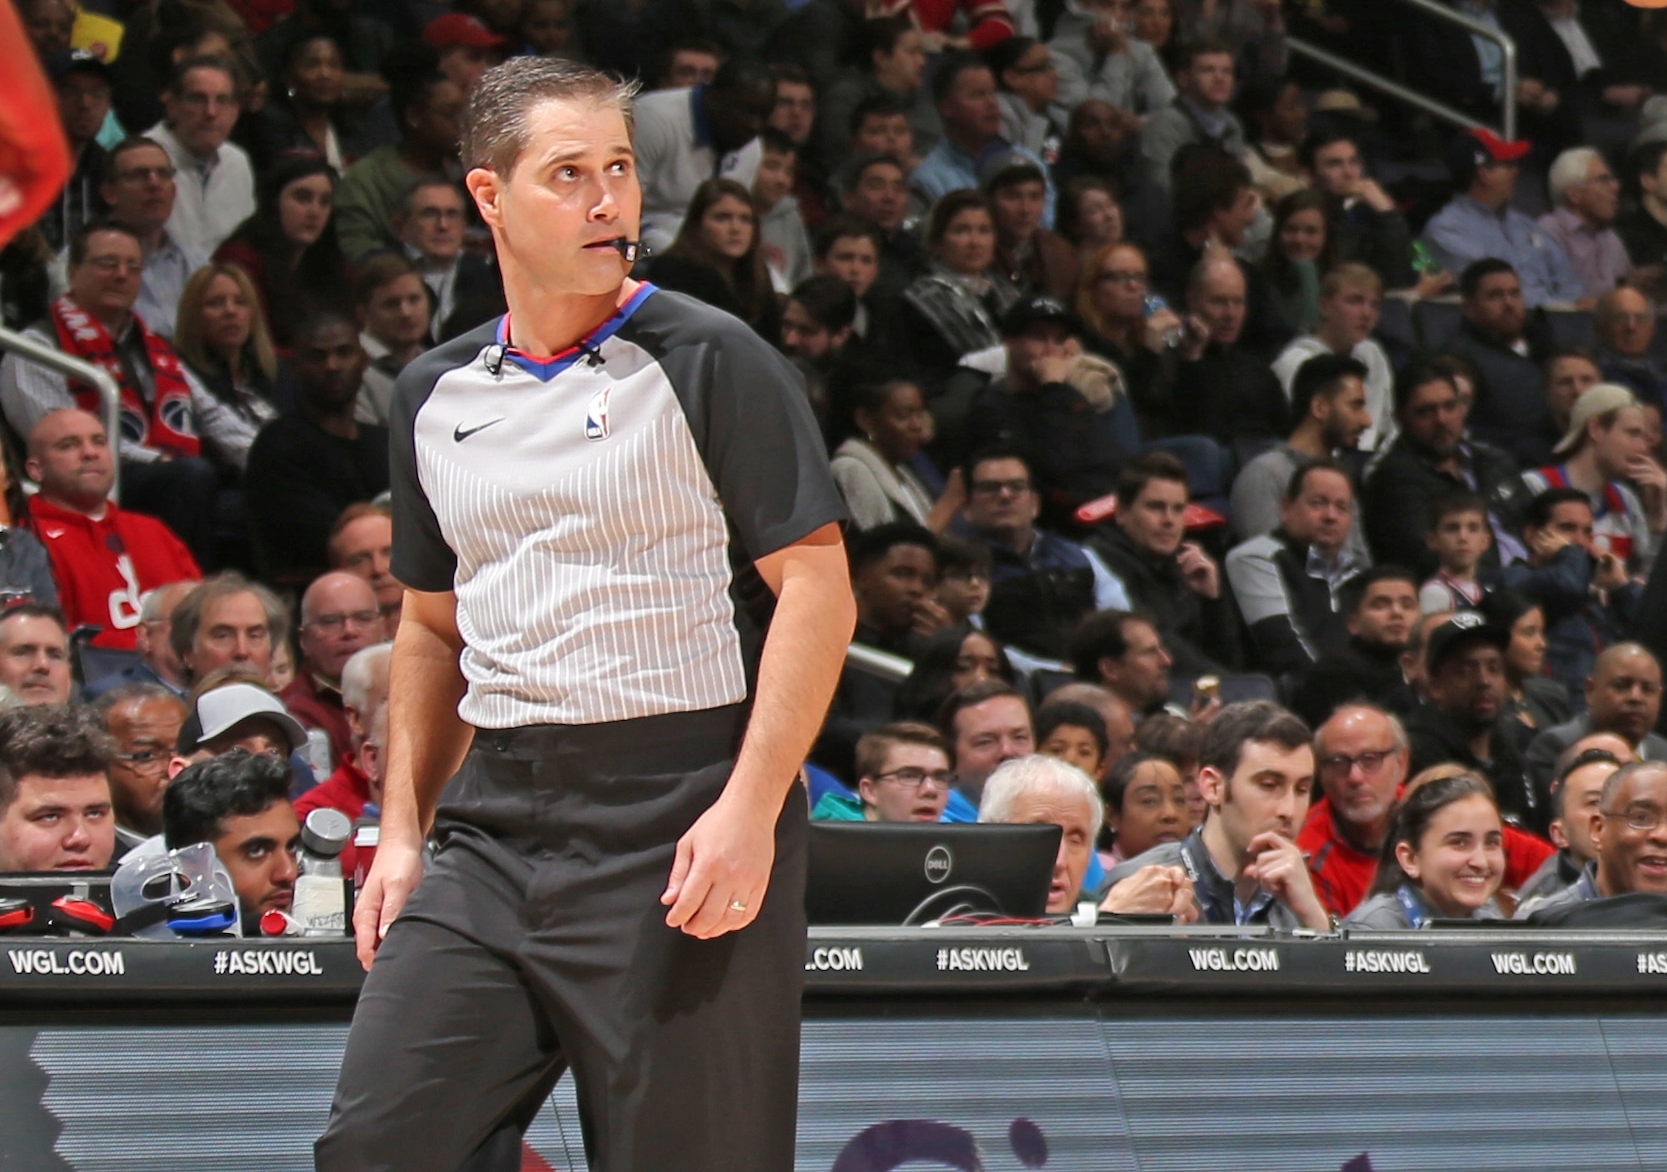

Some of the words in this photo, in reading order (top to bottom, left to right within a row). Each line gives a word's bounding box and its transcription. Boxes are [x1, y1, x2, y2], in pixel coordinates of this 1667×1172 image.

[8, 949, 125, 976] WGL.COM
[214, 950, 323, 975] #ASKWGL
[804, 947, 864, 971] .COM
[936, 947, 1029, 972] #ASKWGL
[1189, 948, 1279, 972] WGL.COM
[1344, 951, 1430, 974] #ASKWGL
[1491, 952, 1576, 976] WGL.COM
